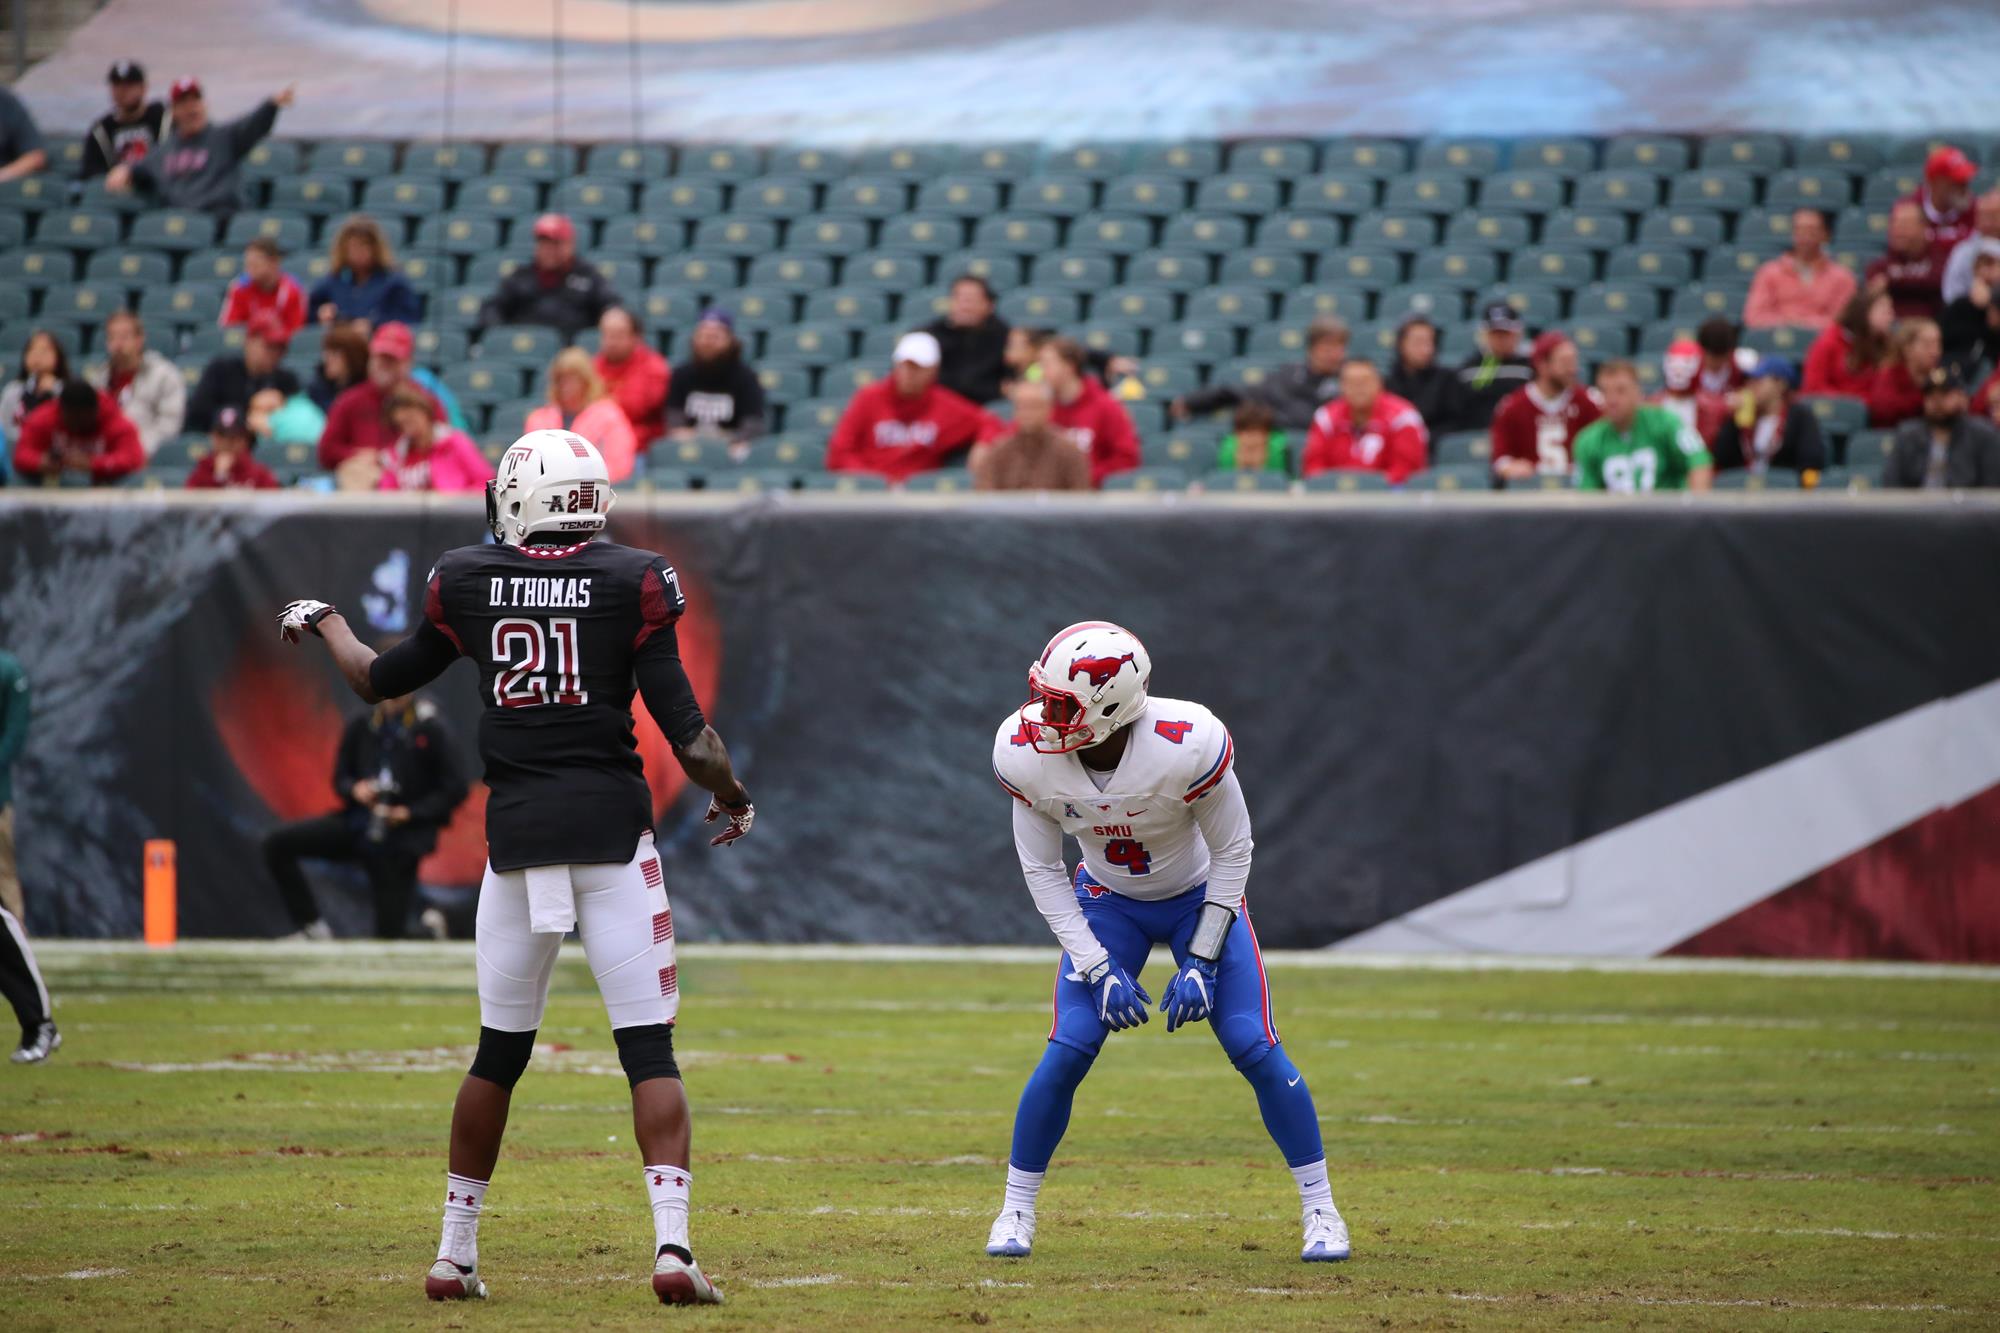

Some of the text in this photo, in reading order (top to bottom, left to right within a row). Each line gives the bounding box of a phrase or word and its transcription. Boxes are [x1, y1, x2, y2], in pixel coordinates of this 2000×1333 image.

[559, 520, 604, 530] TEMPLE
[489, 577, 592, 608] D.THOMAS
[492, 617, 588, 708] 21
[1154, 719, 1194, 745] 4
[1093, 825, 1133, 837] SMU
[1104, 838, 1152, 876] 4
